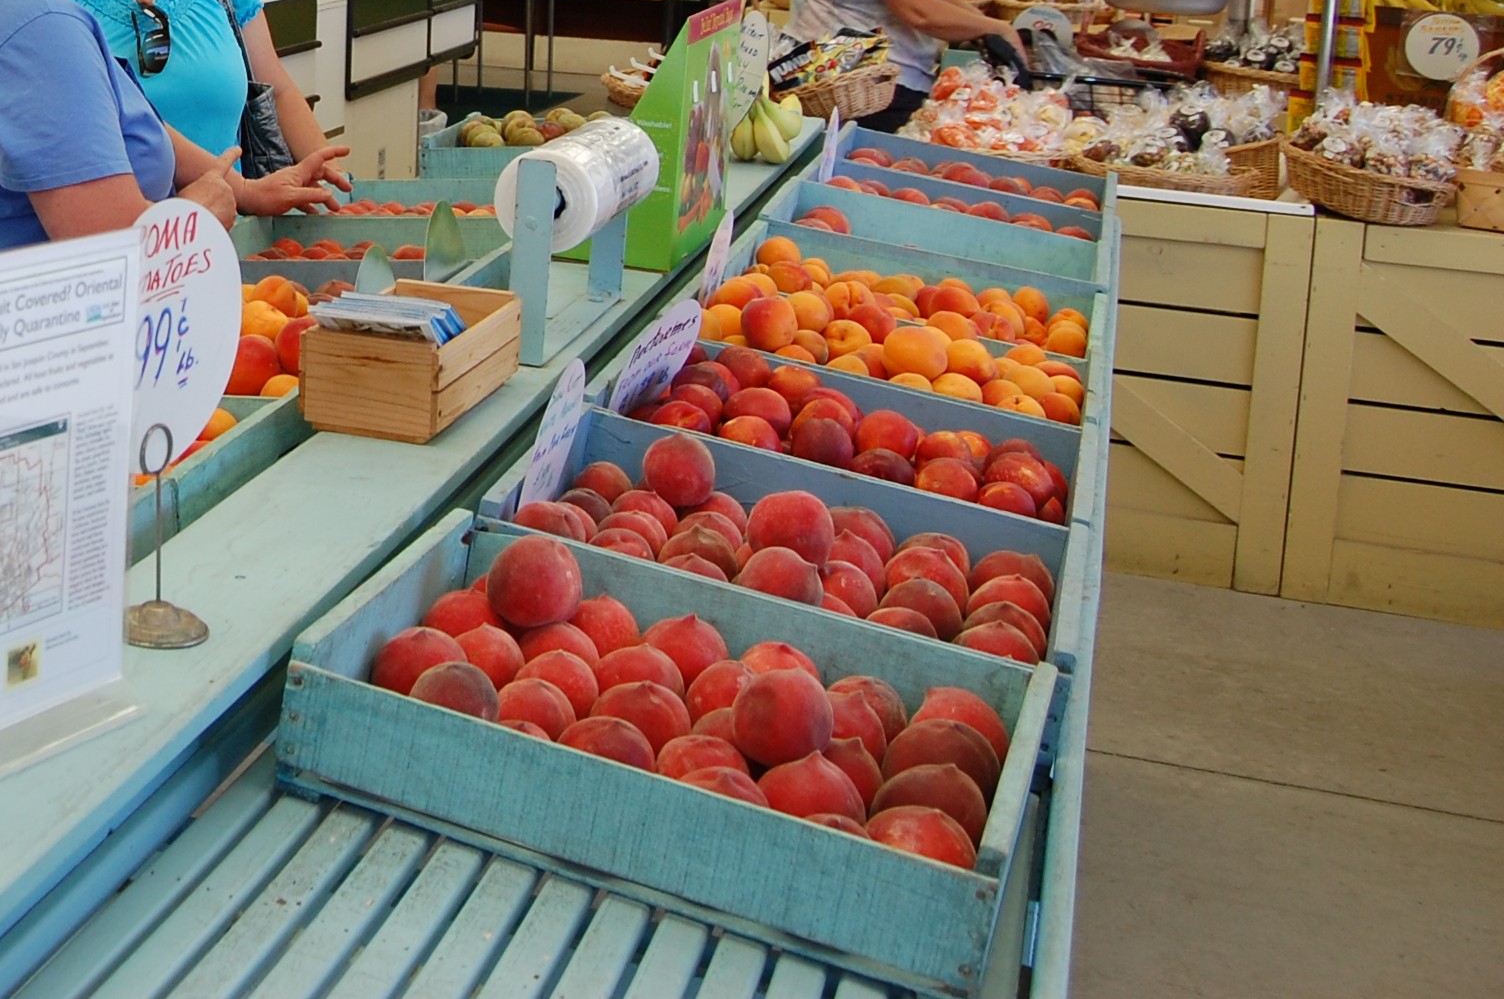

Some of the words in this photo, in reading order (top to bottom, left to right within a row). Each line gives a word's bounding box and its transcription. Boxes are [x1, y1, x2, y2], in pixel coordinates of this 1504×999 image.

[15, 285, 73, 312] Covered?
[75, 274, 123, 299] Oriental
[14, 308, 81, 338] Quarantine
